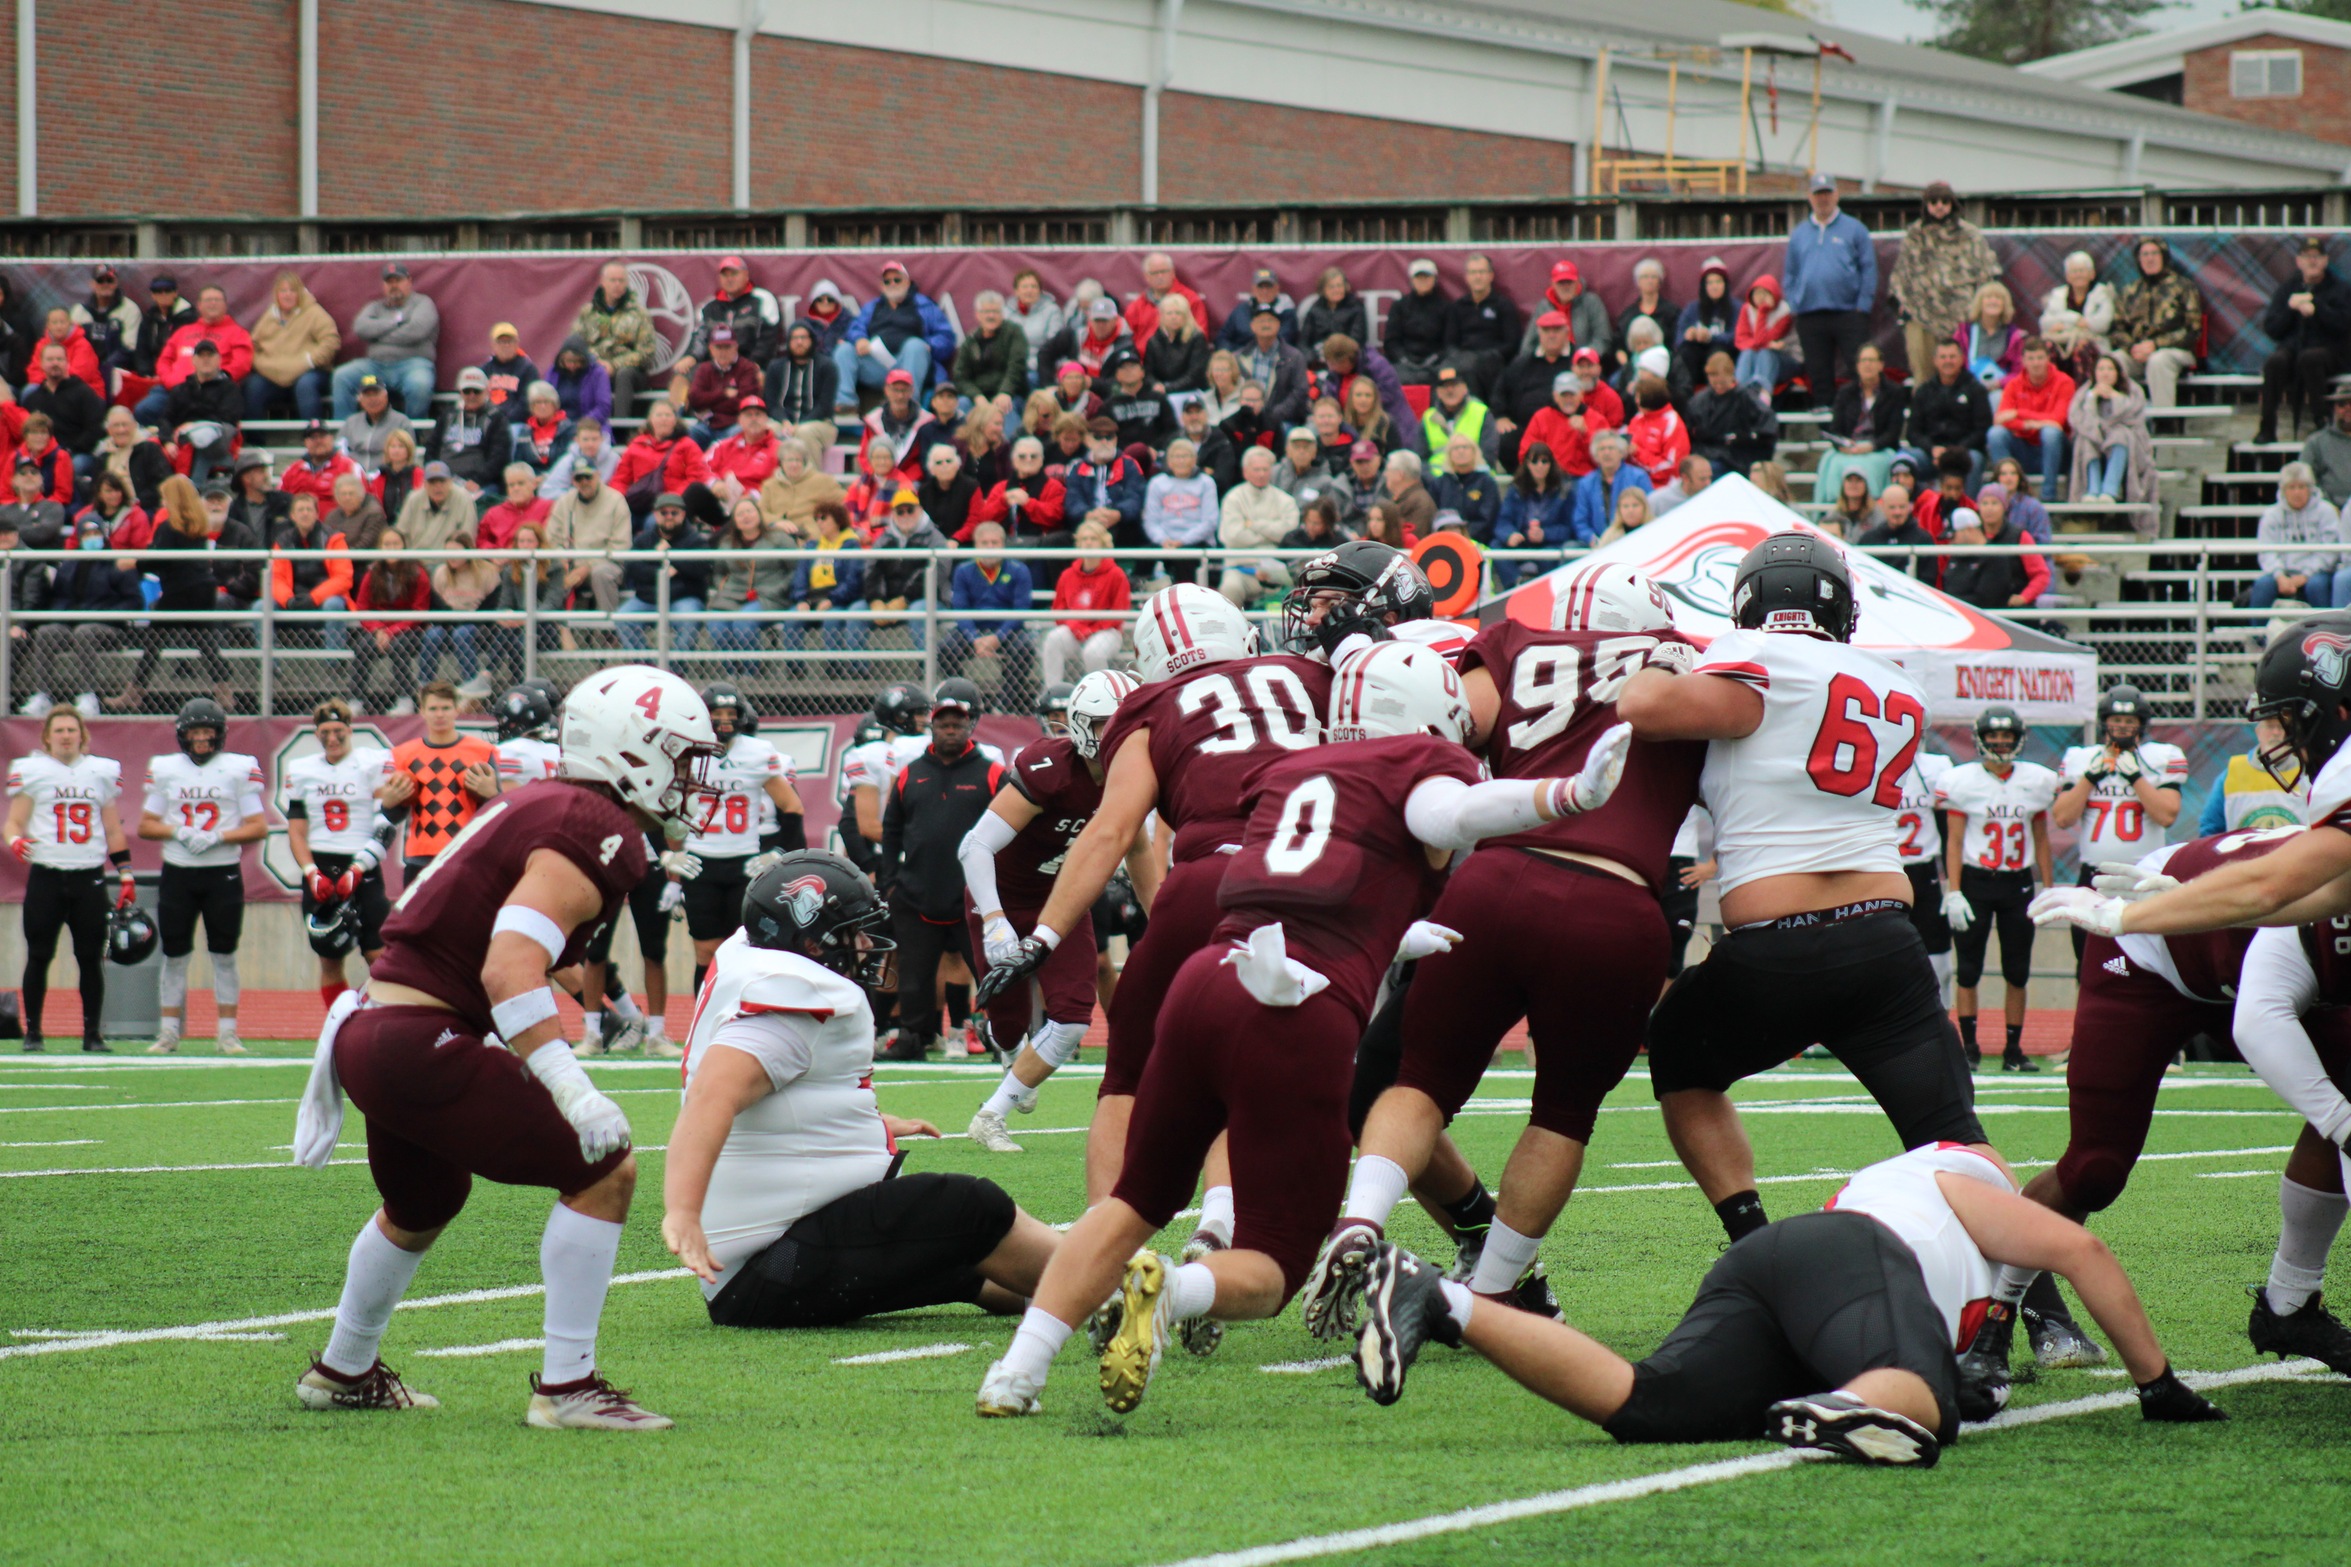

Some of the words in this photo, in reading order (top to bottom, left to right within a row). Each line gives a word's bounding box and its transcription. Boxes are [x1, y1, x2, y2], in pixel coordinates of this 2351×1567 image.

[1773, 611, 1806, 622] KNIGHTS
[1166, 648, 1206, 673] SCOTS
[1661, 649, 1687, 662] adidas
[1955, 665, 2015, 700] KNIGHT
[2017, 668, 2075, 702] NATION
[634, 686, 664, 720] 4
[1177, 665, 1321, 754] 30
[1333, 727, 1367, 742] SCOTS
[1806, 672, 1924, 810] 62
[1030, 757, 1053, 771] 7
[54, 786, 96, 800] MLC
[180, 786, 222, 800] MLC
[317, 783, 357, 797] MLC
[2094, 784, 2136, 797] MLC
[53, 802, 93, 844] 19
[181, 802, 220, 832] 12
[323, 799, 348, 832] 8
[698, 794, 750, 834] 28
[1264, 775, 1337, 876] 0
[1987, 805, 2026, 819] MLC
[2086, 801, 2143, 842] 70
[599, 833, 624, 866] 4
[1979, 823, 2025, 870] 33
[2103, 962, 2130, 977] adidas
